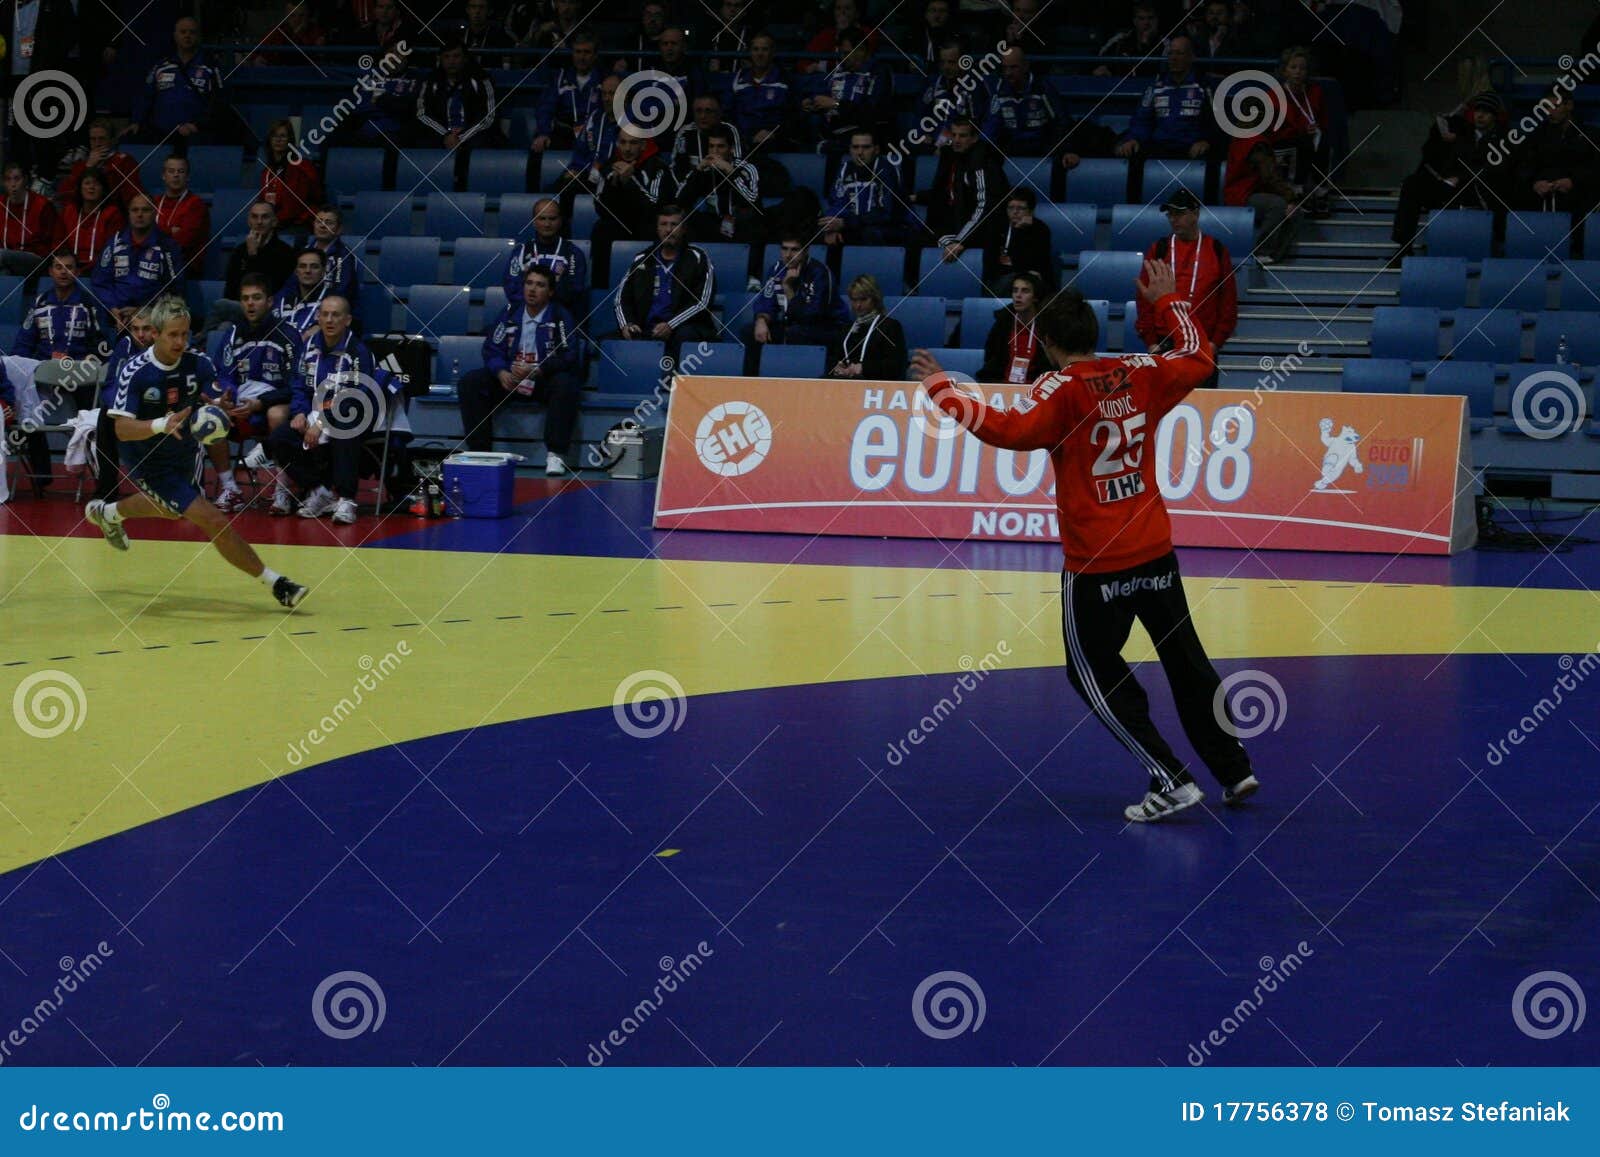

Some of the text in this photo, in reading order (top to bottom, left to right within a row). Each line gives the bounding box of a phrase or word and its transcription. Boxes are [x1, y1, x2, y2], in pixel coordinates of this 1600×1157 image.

[185, 374, 199, 396] 5
[701, 409, 767, 463] EHF
[1090, 412, 1147, 477] 25
[1100, 571, 1174, 603] Metronet
